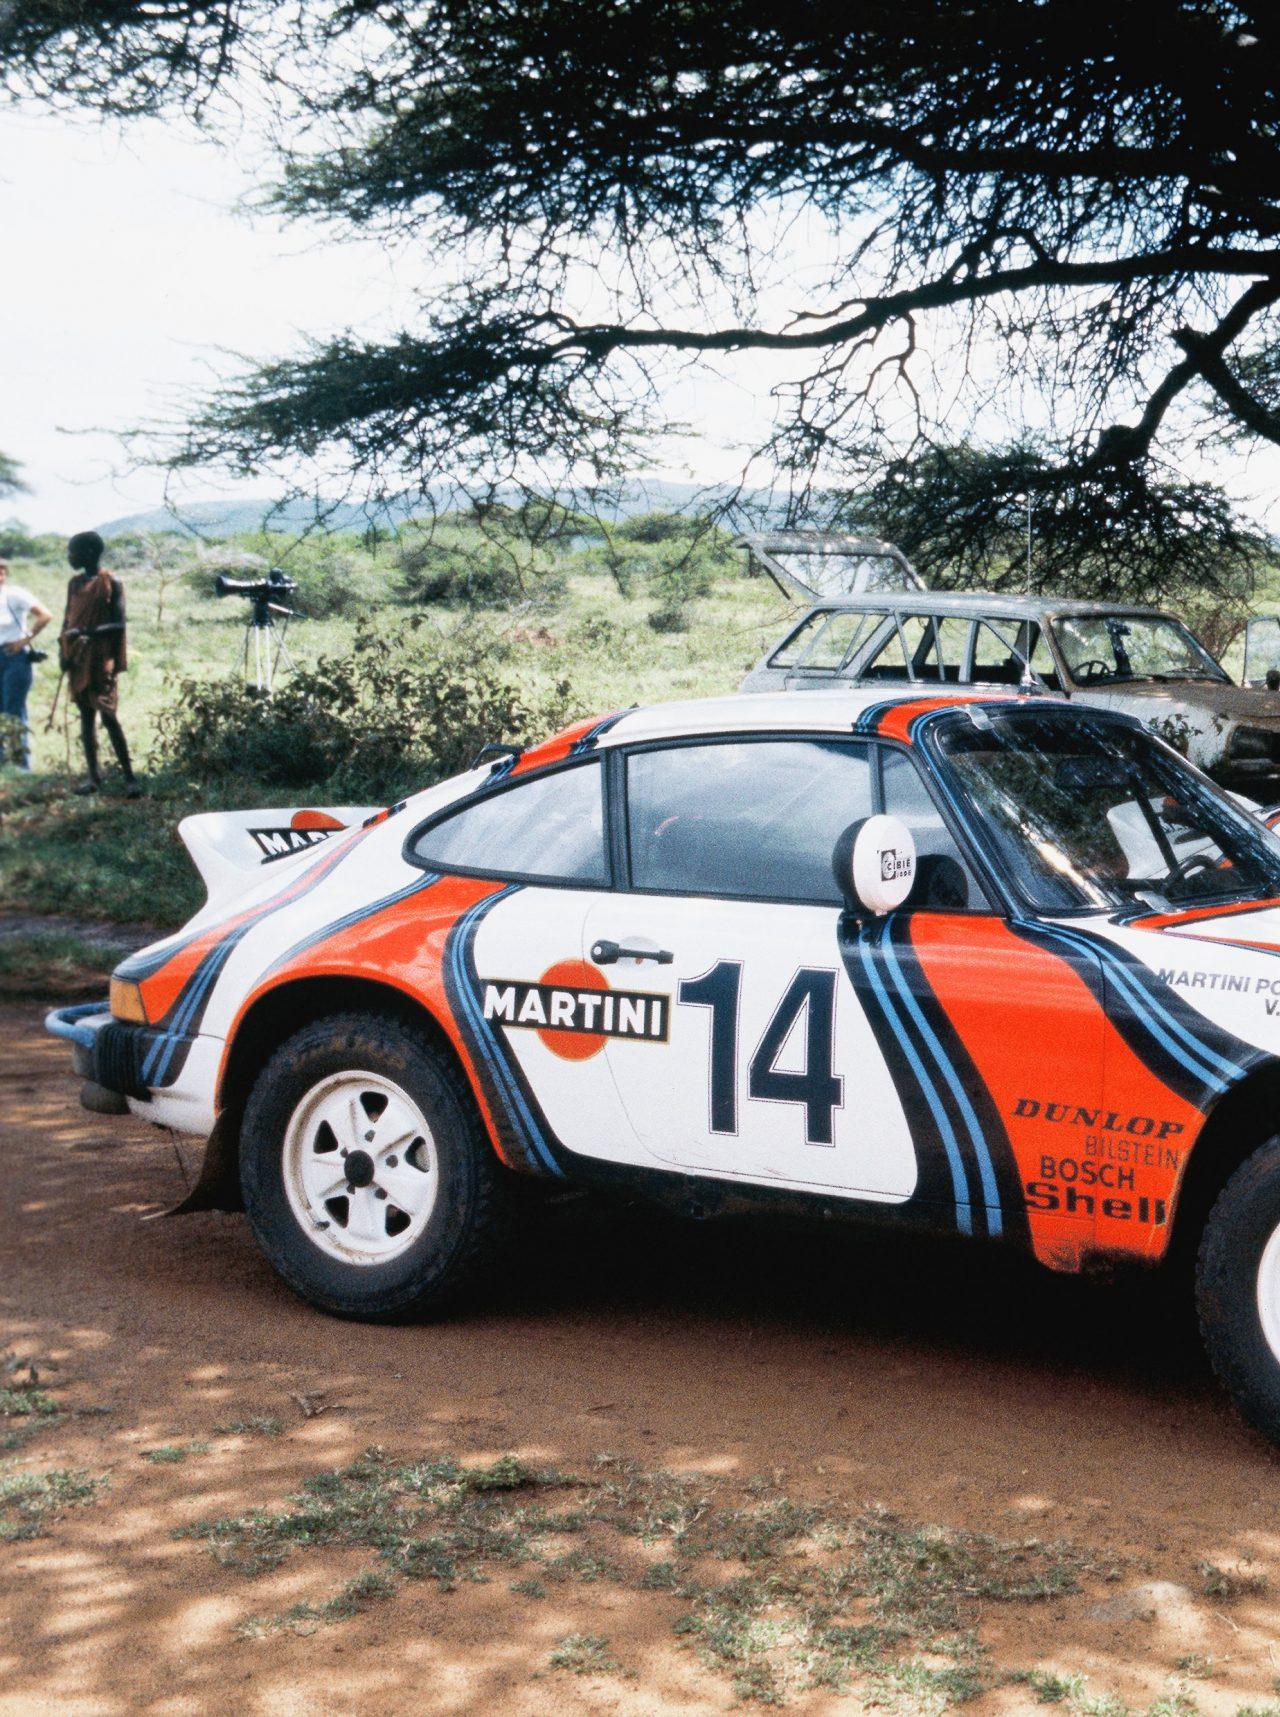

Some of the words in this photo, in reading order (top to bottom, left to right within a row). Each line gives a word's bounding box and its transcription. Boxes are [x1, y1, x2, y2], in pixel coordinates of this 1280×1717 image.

[1157, 967, 1251, 993] MARTINI
[483, 985, 662, 1036] MARTINI
[677, 959, 845, 1148] 14
[1013, 1097, 1185, 1139] DUNLOP
[1040, 1154, 1136, 1191] BOSCH
[1085, 1134, 1182, 1170] BILSTEIN
[1025, 1181, 1167, 1225] Shell
